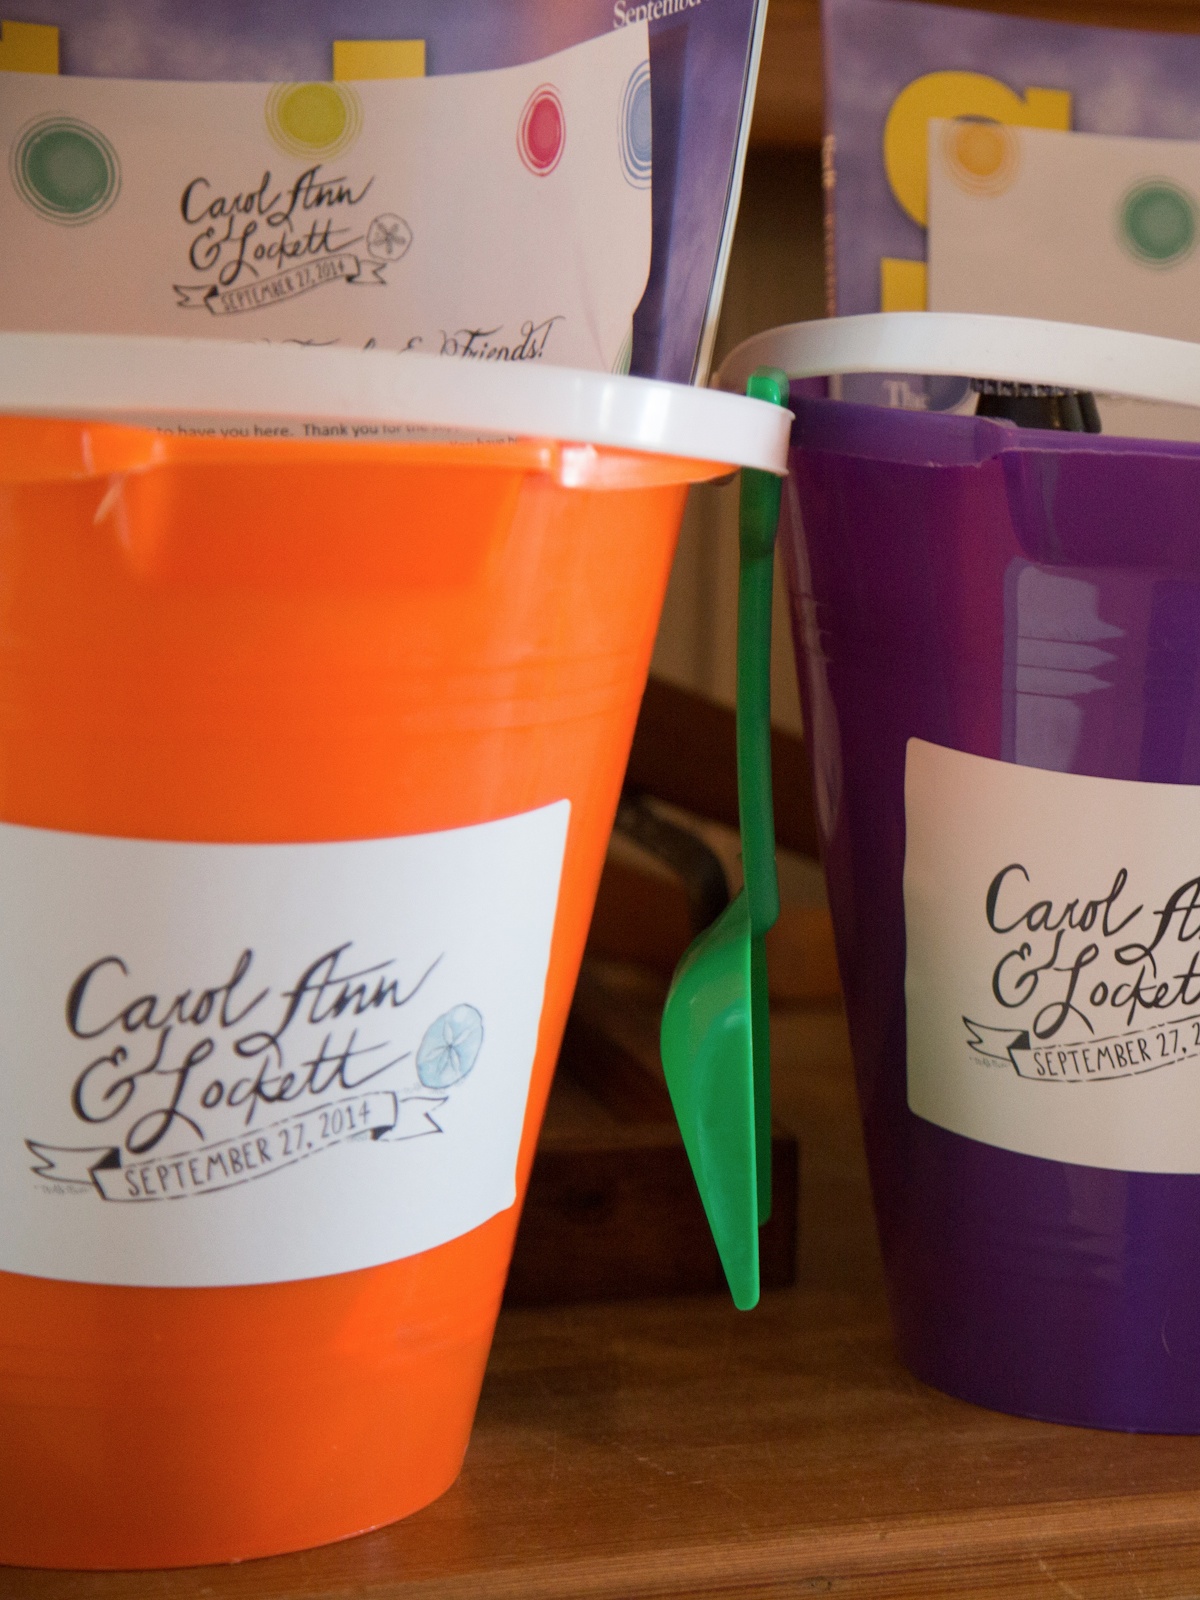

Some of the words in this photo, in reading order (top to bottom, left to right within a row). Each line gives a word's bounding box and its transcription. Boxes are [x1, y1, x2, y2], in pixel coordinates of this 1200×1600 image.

[180, 170, 282, 224] Carol
[266, 164, 375, 232] Ann
[178, 424, 215, 437] have
[220, 427, 249, 440] you
[254, 424, 294, 437] here.
[303, 423, 348, 437] Thank
[351, 425, 379, 438] you
[986, 864, 1143, 936] Carol
[66, 949, 270, 1039] Carol
[234, 941, 445, 1067] Ann
[1034, 1038, 1151, 1076] SEPTEMBER
[1156, 1029, 1187, 1057] 27,
[126, 1029, 411, 1153] Lockett
[125, 1137, 272, 1197] SEPTEMBER
[279, 1124, 313, 1155] 27,
[320, 1101, 370, 1139] 2014
